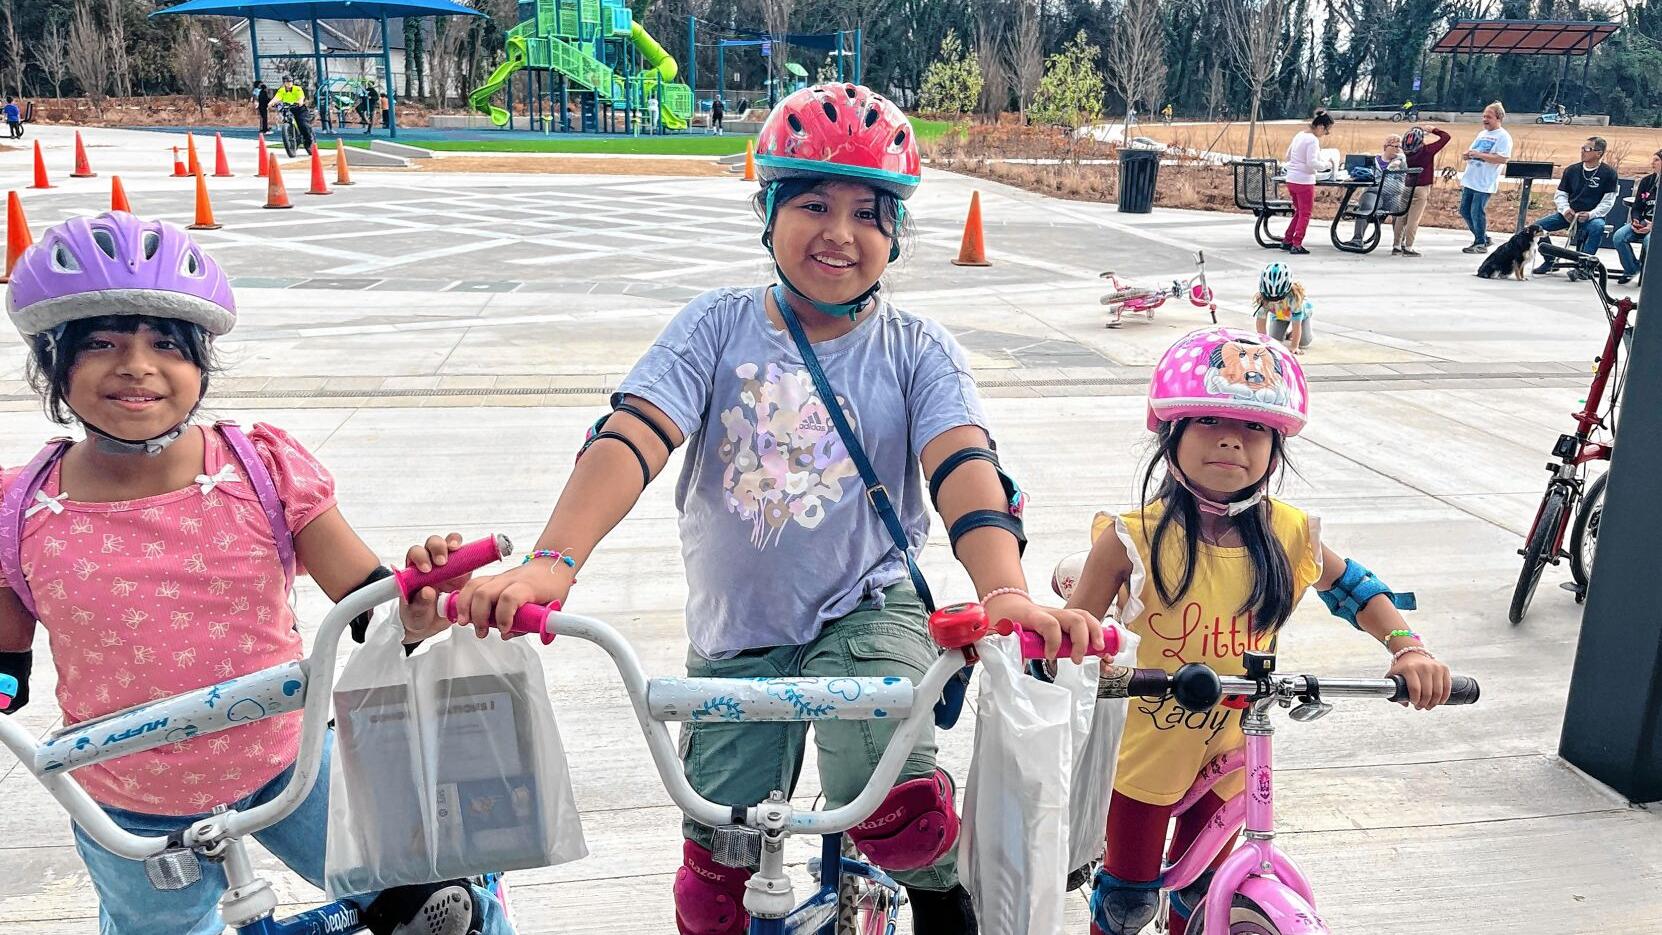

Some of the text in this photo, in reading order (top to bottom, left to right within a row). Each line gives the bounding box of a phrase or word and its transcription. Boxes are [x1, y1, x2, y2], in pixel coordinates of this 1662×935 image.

[799, 423, 826, 431] adidas
[100, 716, 169, 746] HUFFY
[857, 806, 904, 830] Razor
[688, 857, 726, 882] Razor
